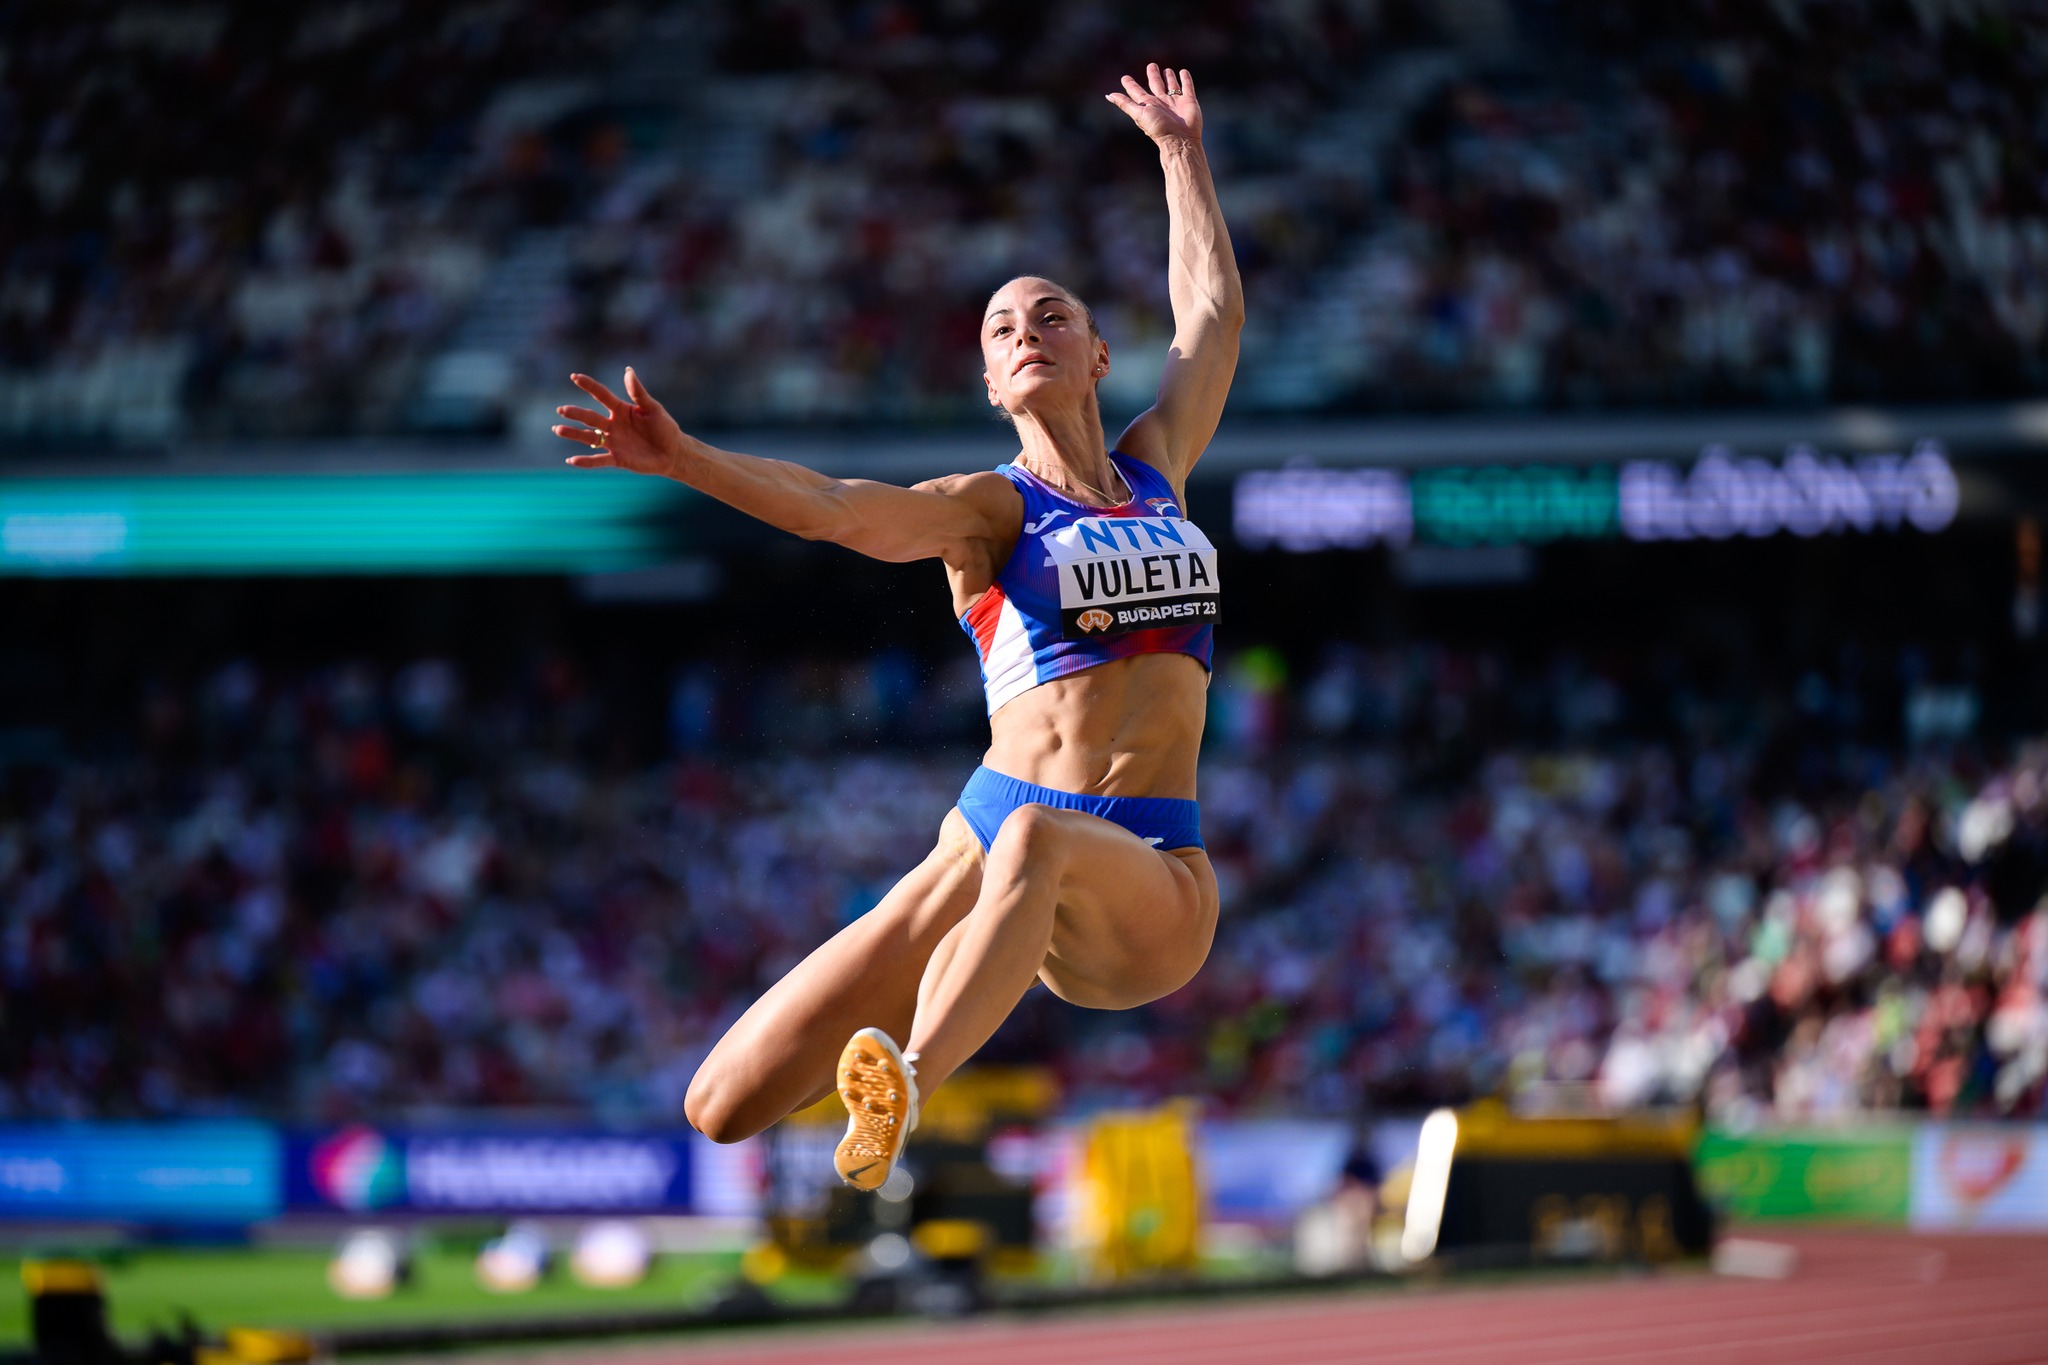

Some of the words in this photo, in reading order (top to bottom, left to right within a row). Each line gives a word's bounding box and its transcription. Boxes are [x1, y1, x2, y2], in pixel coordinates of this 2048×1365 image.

[1076, 519, 1186, 555] NTN
[1072, 552, 1210, 600] VULETA
[1117, 602, 1201, 624] BUDAPEST
[1202, 601, 1217, 615] 23
